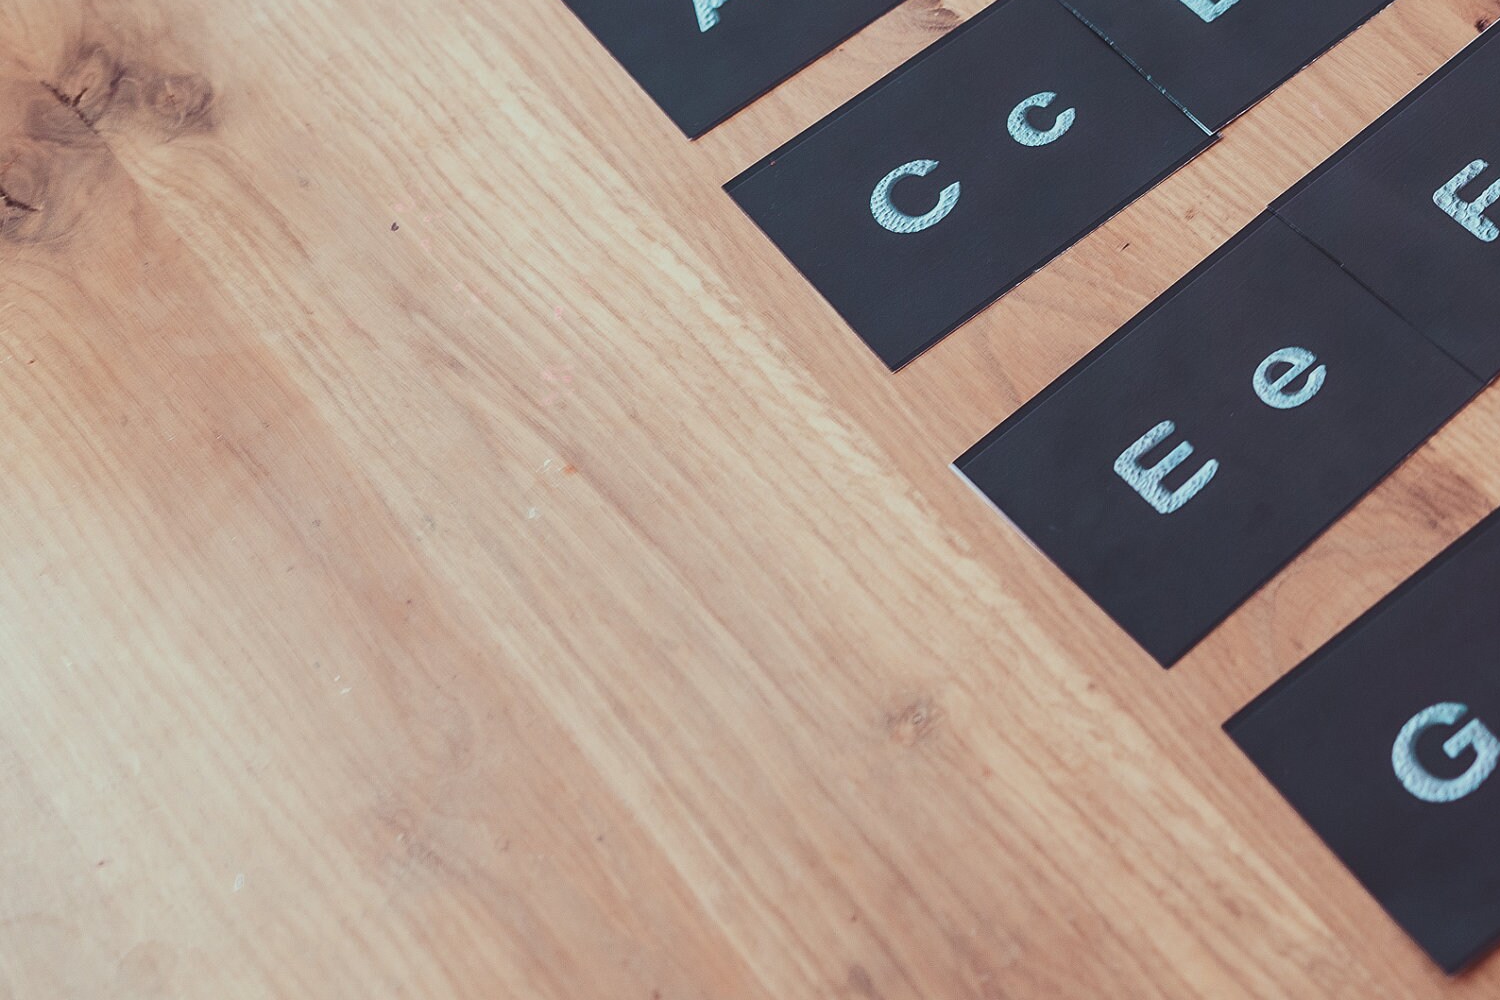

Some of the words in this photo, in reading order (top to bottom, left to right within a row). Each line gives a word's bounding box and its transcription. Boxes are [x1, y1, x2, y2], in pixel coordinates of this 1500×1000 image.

[868, 158, 962, 235] C
[1005, 90, 1077, 148] c
[1112, 419, 1220, 515] E
[1251, 345, 1328, 411] e
